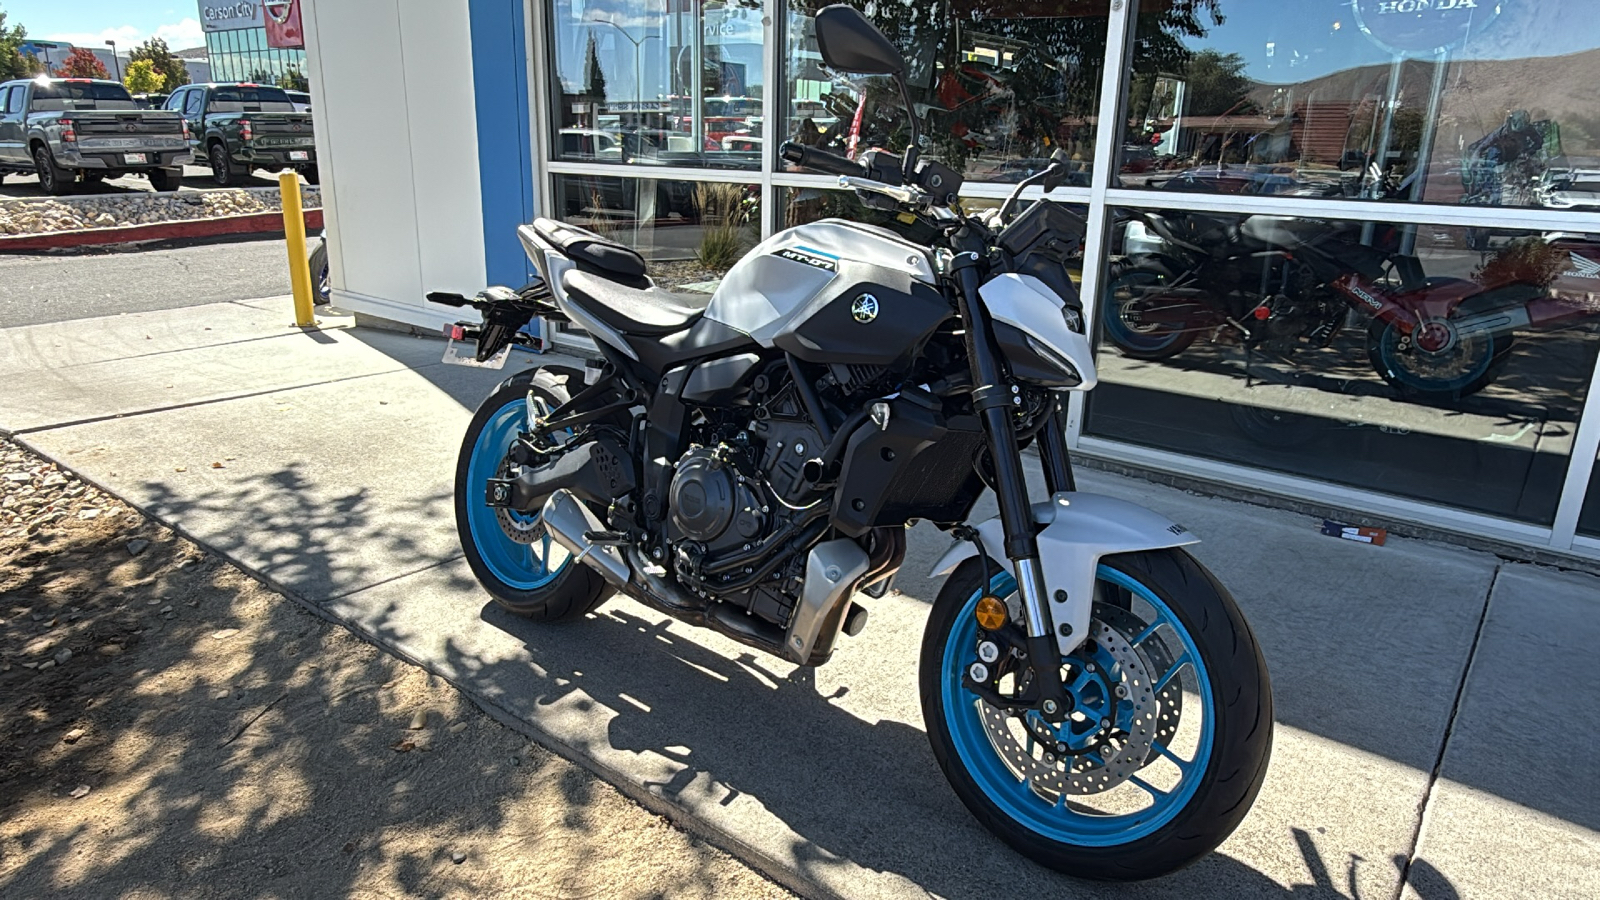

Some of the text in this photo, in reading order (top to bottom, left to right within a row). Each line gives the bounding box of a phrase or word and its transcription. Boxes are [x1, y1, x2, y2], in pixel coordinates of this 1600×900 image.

[204, 1, 254, 20] Carson City
[782, 251, 834, 269] MT-07
[1562, 270, 1600, 279] HONDA
